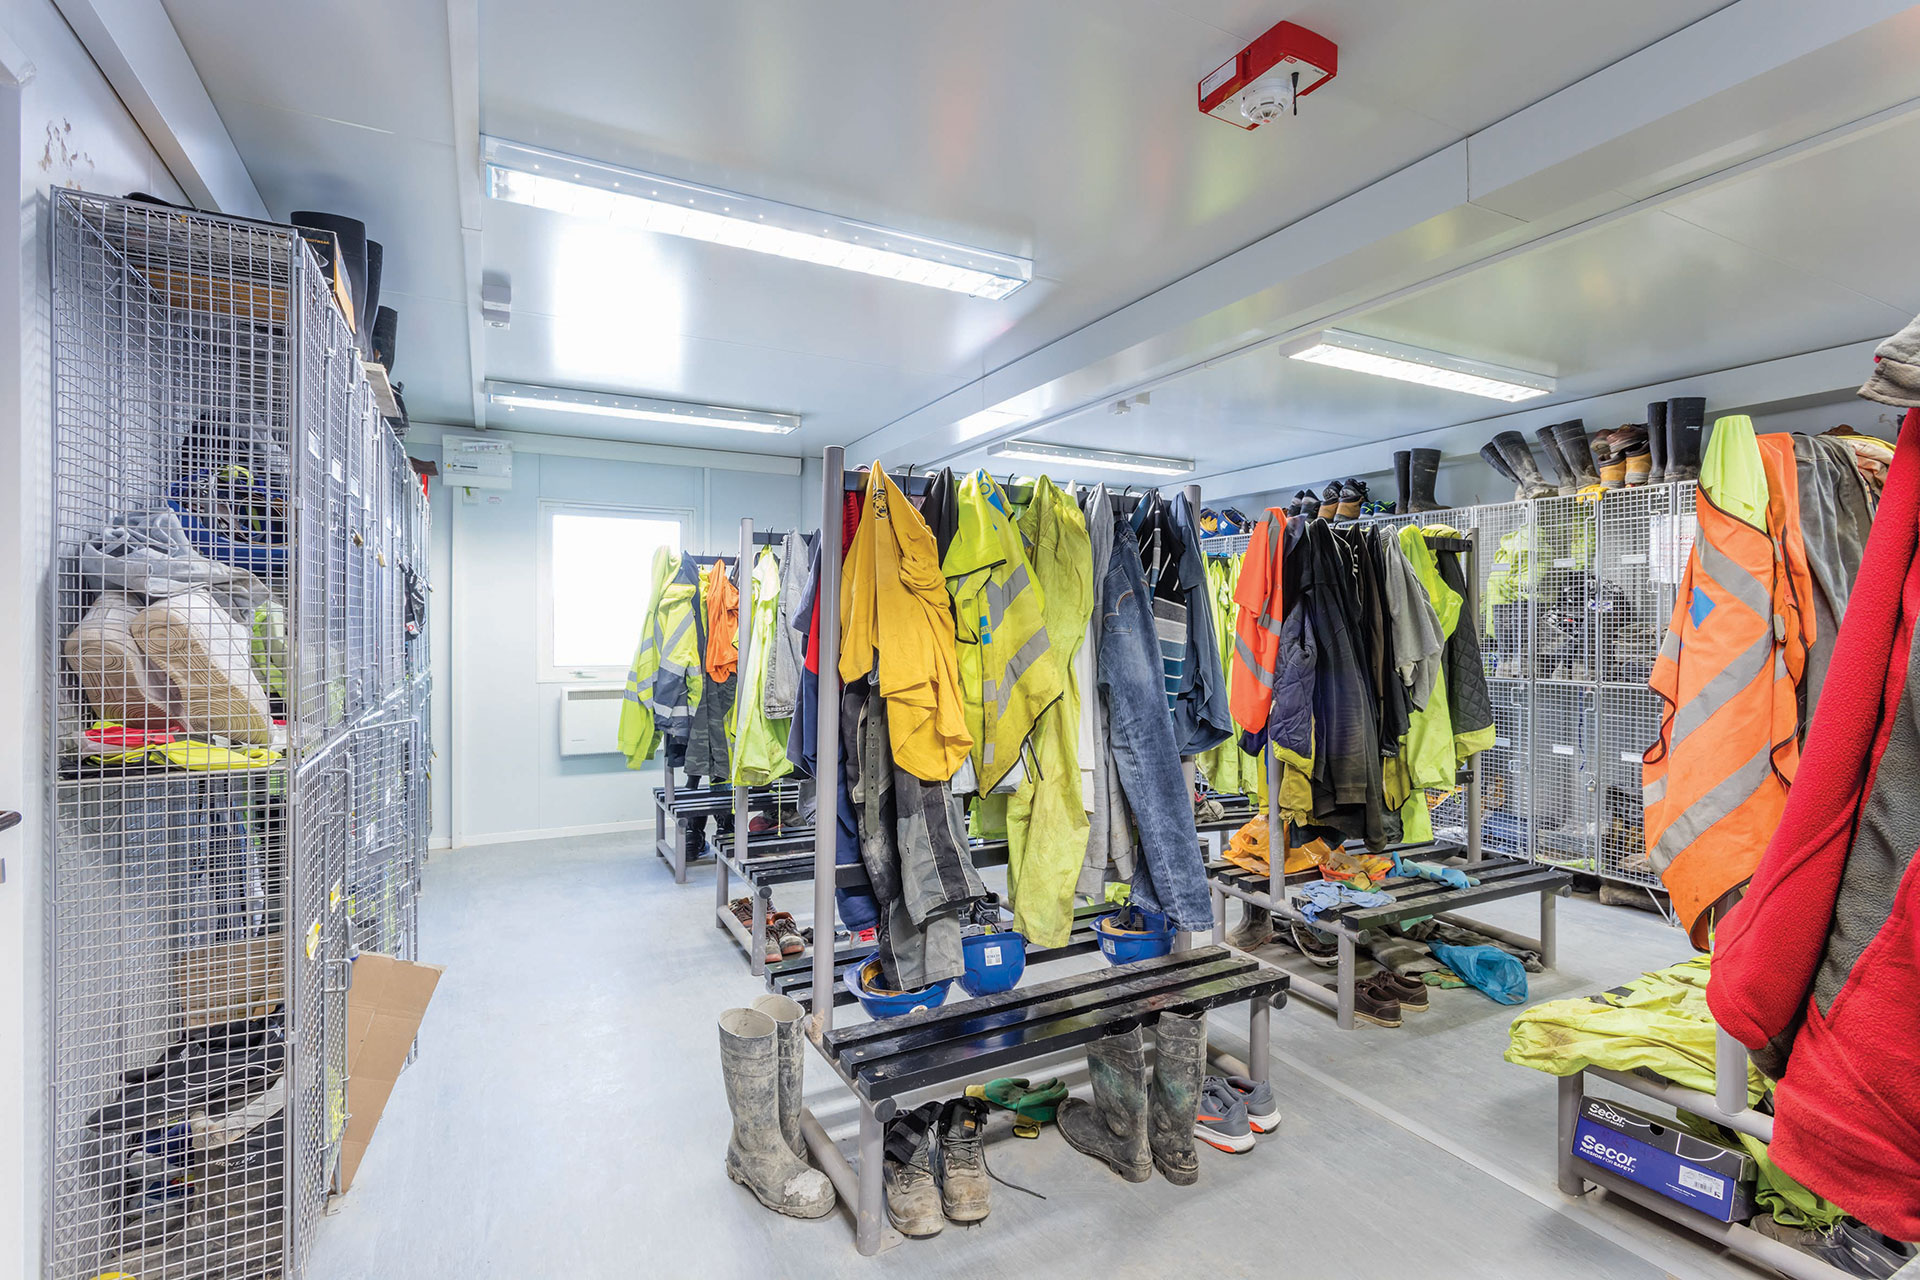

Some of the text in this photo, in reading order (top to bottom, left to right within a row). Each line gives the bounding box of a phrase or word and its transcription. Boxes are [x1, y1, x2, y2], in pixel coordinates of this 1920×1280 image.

[1589, 1103, 1626, 1123] Secor
[1579, 1147, 1635, 1173] PASSION FOR SAFETY
[1581, 1135, 1637, 1166] Secor
